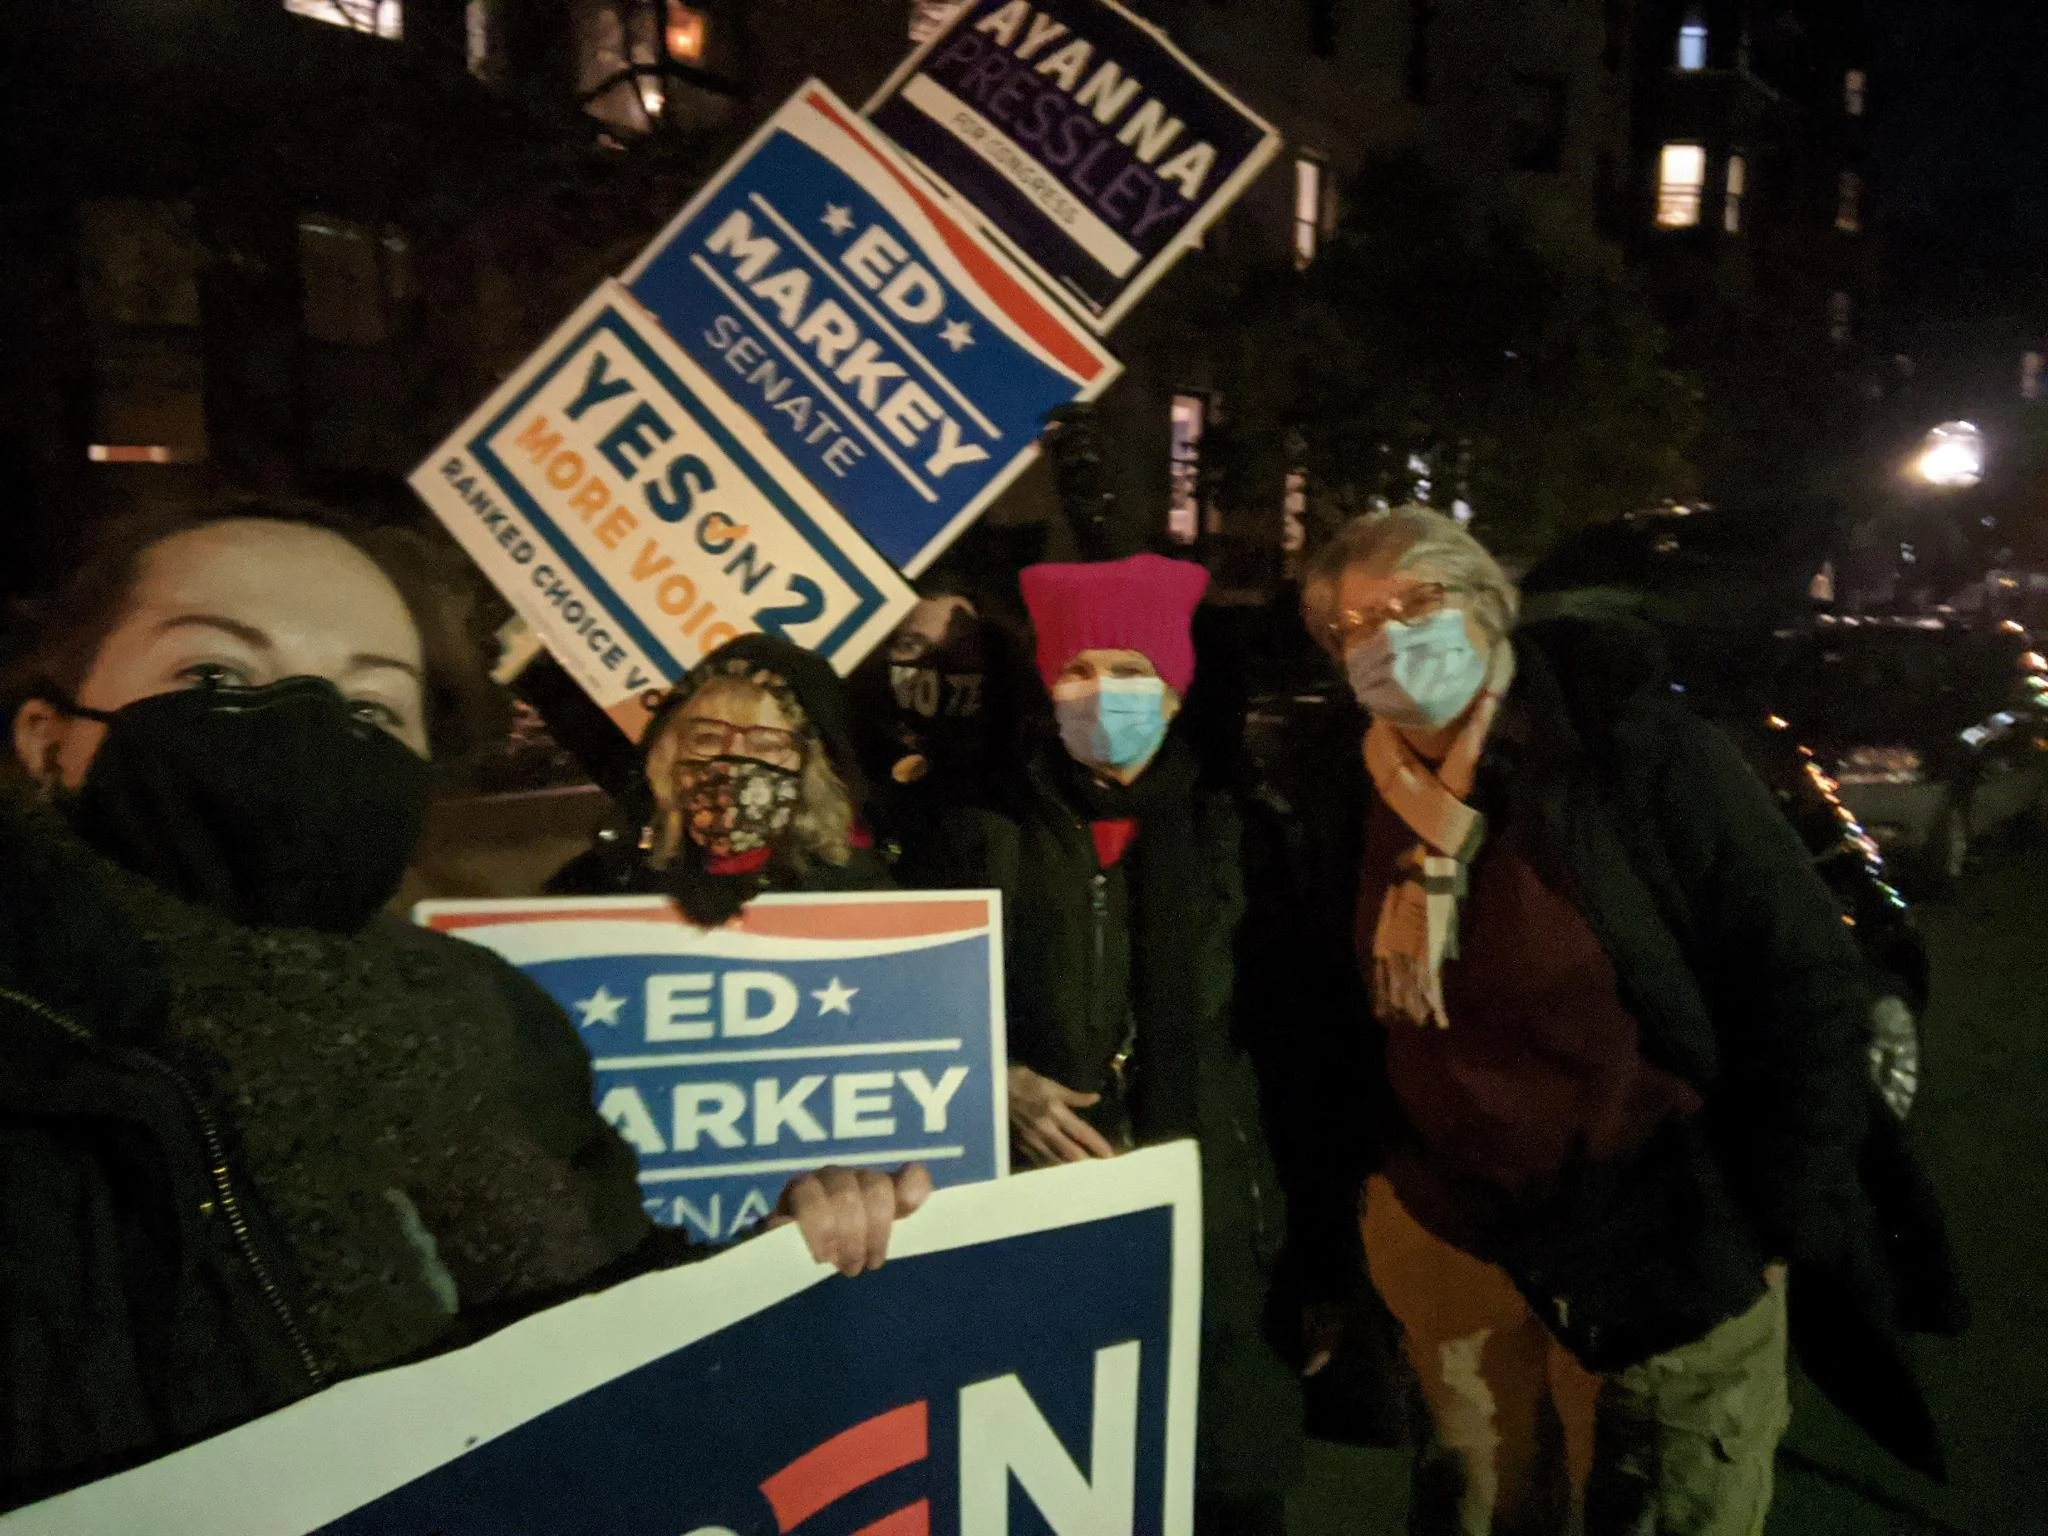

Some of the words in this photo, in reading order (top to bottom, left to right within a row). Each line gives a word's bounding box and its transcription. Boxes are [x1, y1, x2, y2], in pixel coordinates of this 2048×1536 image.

[935, 34, 1188, 238] PRESSLEY
[974, 0, 1219, 200] AYANNA
[703, 209, 991, 478] MARKEY
[840, 223, 946, 326] ED
[514, 415, 641, 551] MORE
[703, 313, 866, 478] SENATE
[439, 457, 535, 565] RANKED
[531, 564, 629, 671] CHOICE
[562, 351, 718, 524] YES
[695, 511, 777, 596] ON
[752, 573, 827, 652] 2
[643, 971, 800, 1043] ED
[598, 1066, 970, 1157] ARKEY
